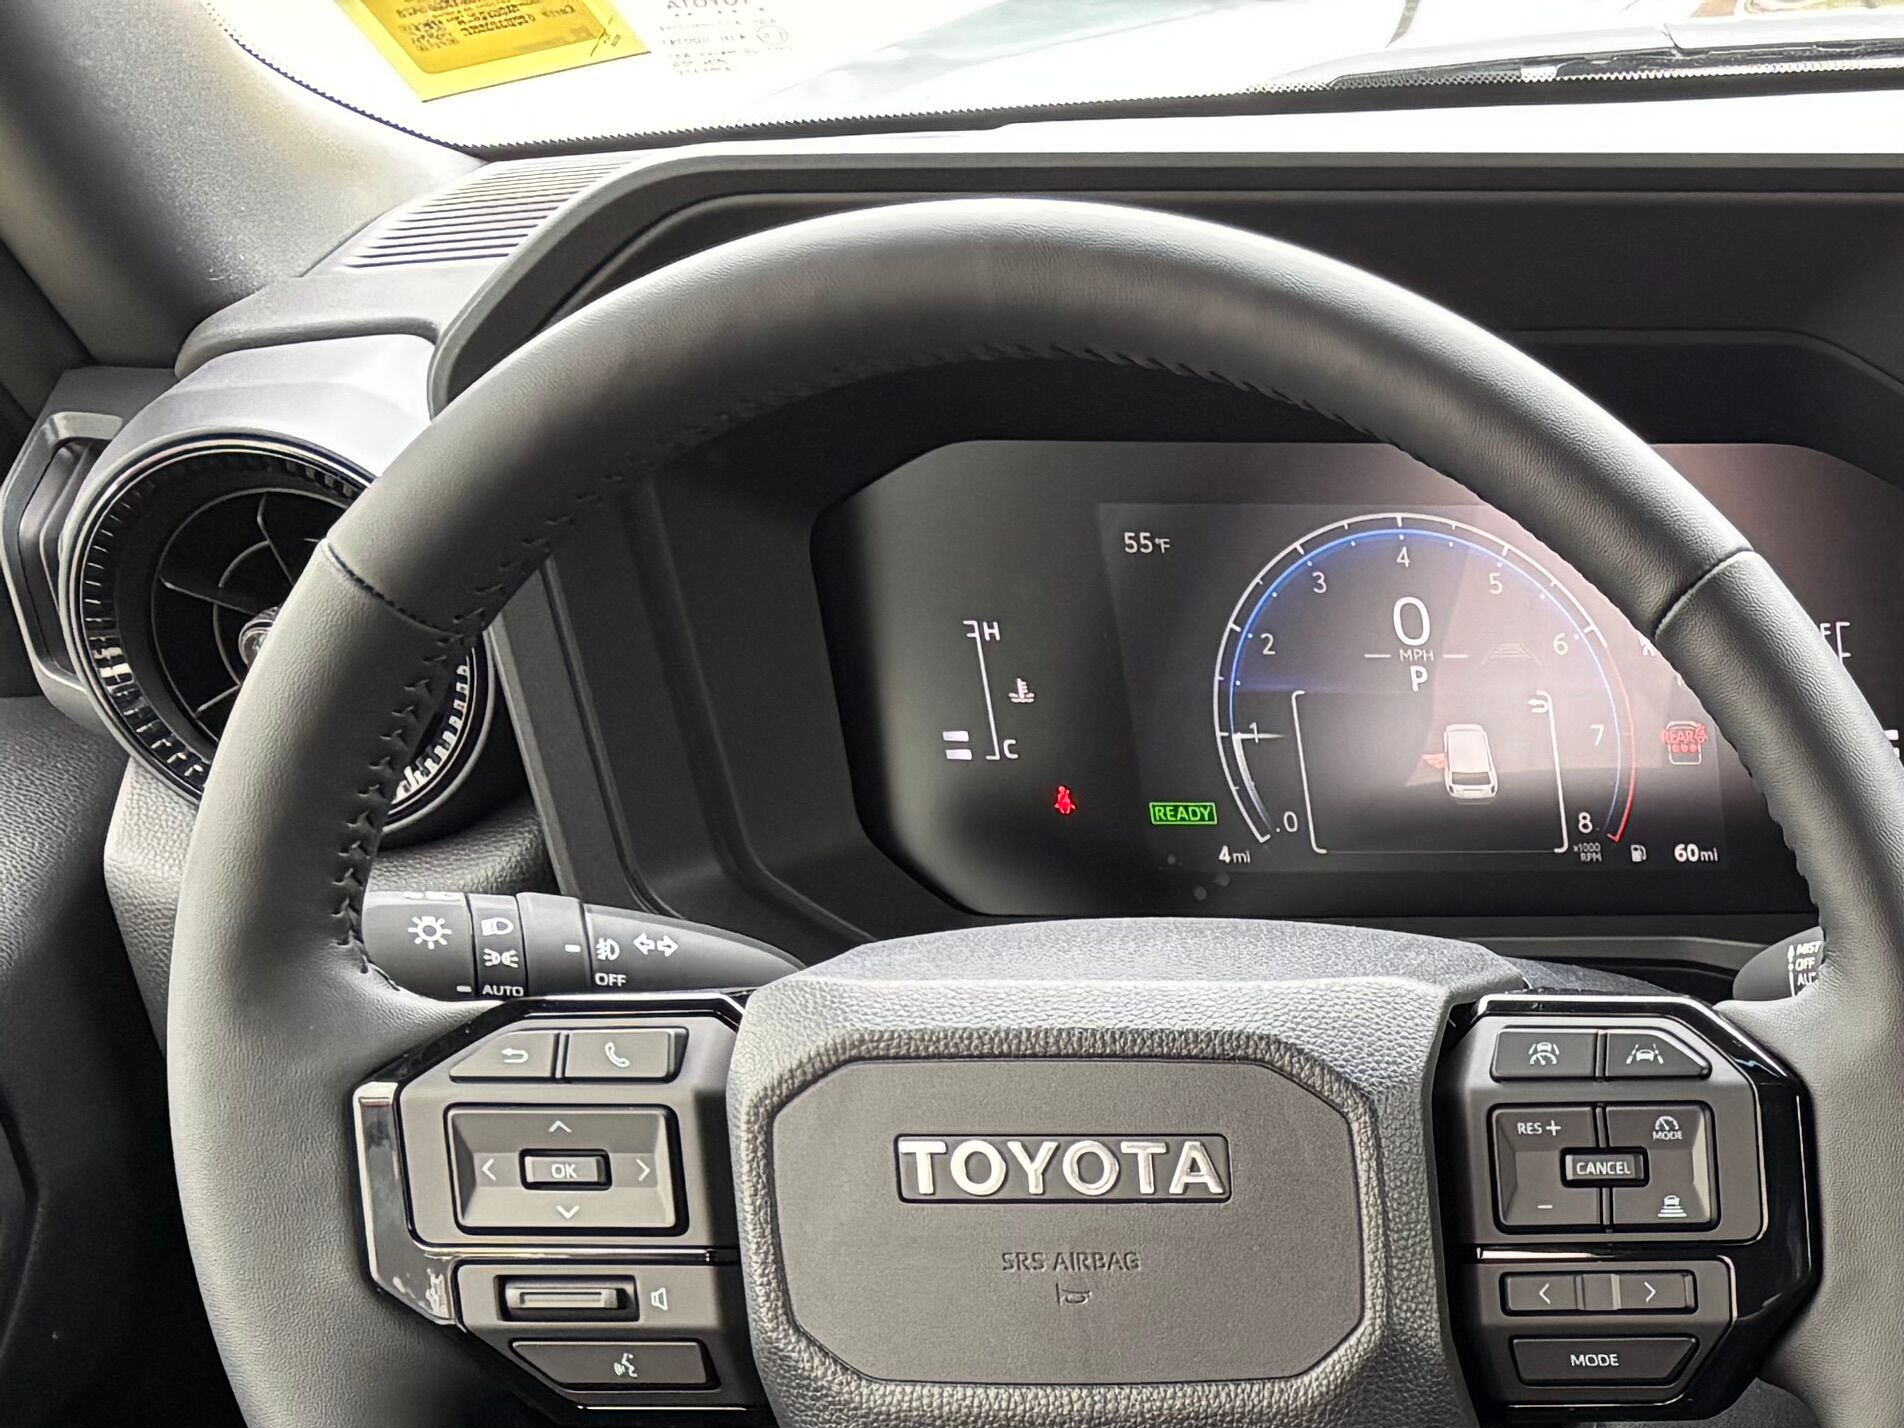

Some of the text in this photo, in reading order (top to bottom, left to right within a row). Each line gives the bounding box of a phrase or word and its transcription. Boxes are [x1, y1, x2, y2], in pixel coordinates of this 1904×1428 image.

[1395, 548, 1411, 568] 4
[1312, 572, 1327, 594] 3
[1489, 573, 1504, 595] 5
[982, 621, 1001, 642] H
[1392, 596, 1431, 646] 0
[1261, 633, 1277, 656] 2
[1553, 633, 1569, 656] 6
[1399, 648, 1435, 663] MPH
[1410, 666, 1429, 692] P
[1590, 724, 1605, 746] 7
[1002, 738, 1019, 760] C
[1154, 805, 1212, 823] READY
[1282, 811, 1299, 833] 0
[1578, 812, 1593, 833] 8
[1795, 956, 1816, 971] OFF
[482, 983, 524, 997] AUTO
[594, 972, 627, 987] OFF
[1652, 1130, 1684, 1141] MODE
[549, 1161, 577, 1180] OK
[898, 1138, 1224, 1198] TOYOTA
[1575, 1161, 1632, 1176] CANCEL
[1000, 1250, 1141, 1272] SRS AIRBAG
[1570, 1351, 1620, 1369] MODE
